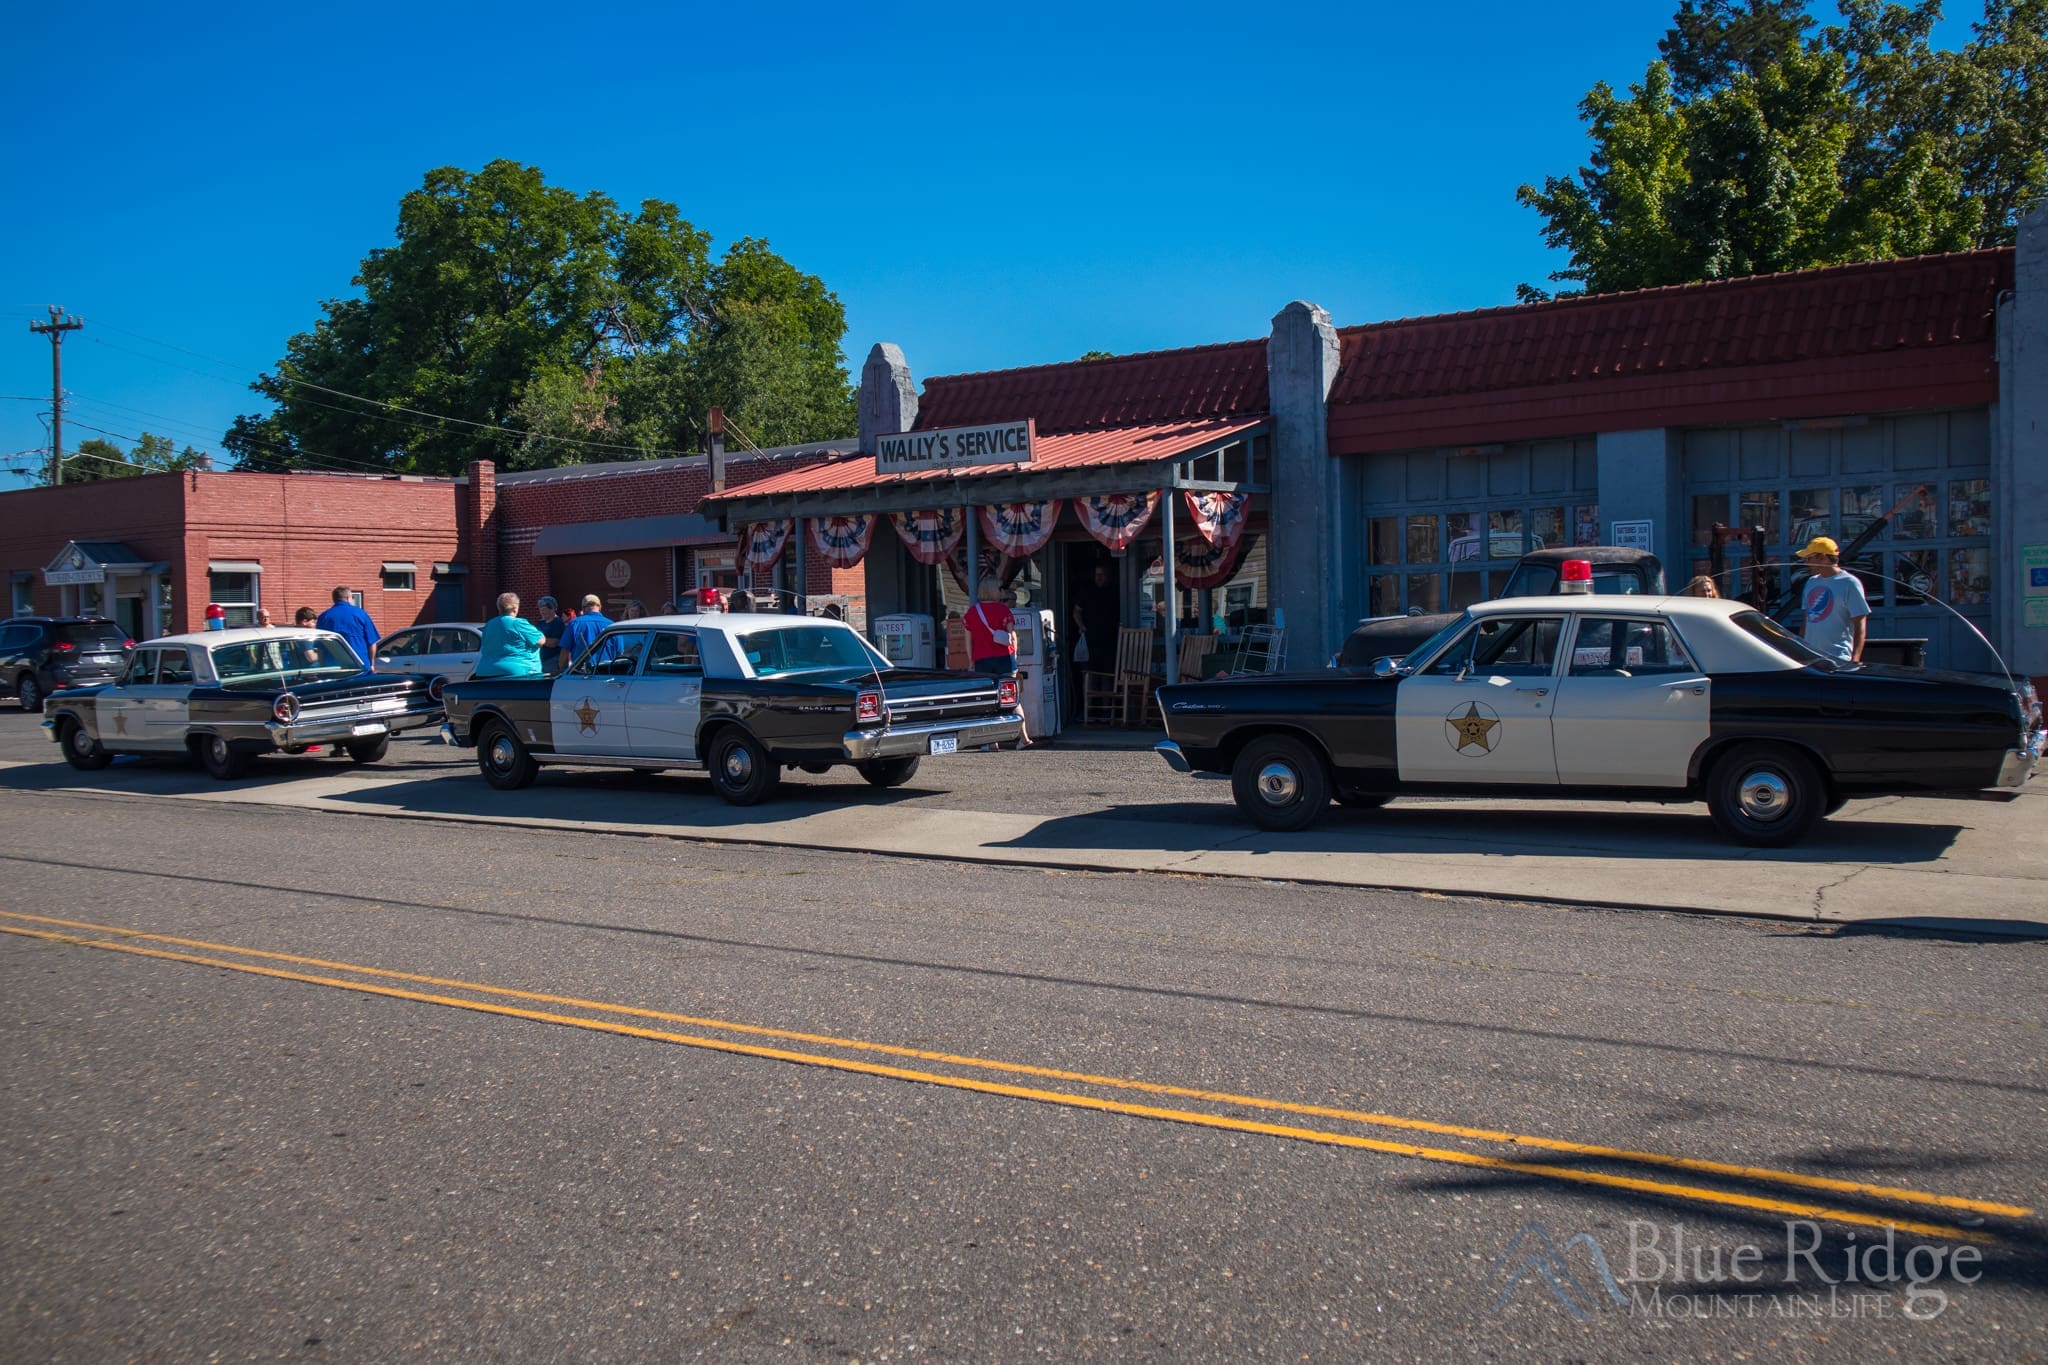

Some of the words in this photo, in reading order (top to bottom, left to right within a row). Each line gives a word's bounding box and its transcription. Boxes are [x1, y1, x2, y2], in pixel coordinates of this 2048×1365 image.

[880, 432, 949, 463] WALLY'S
[956, 427, 1028, 457] SERVICE
[877, 623, 905, 632] HI-TEST
